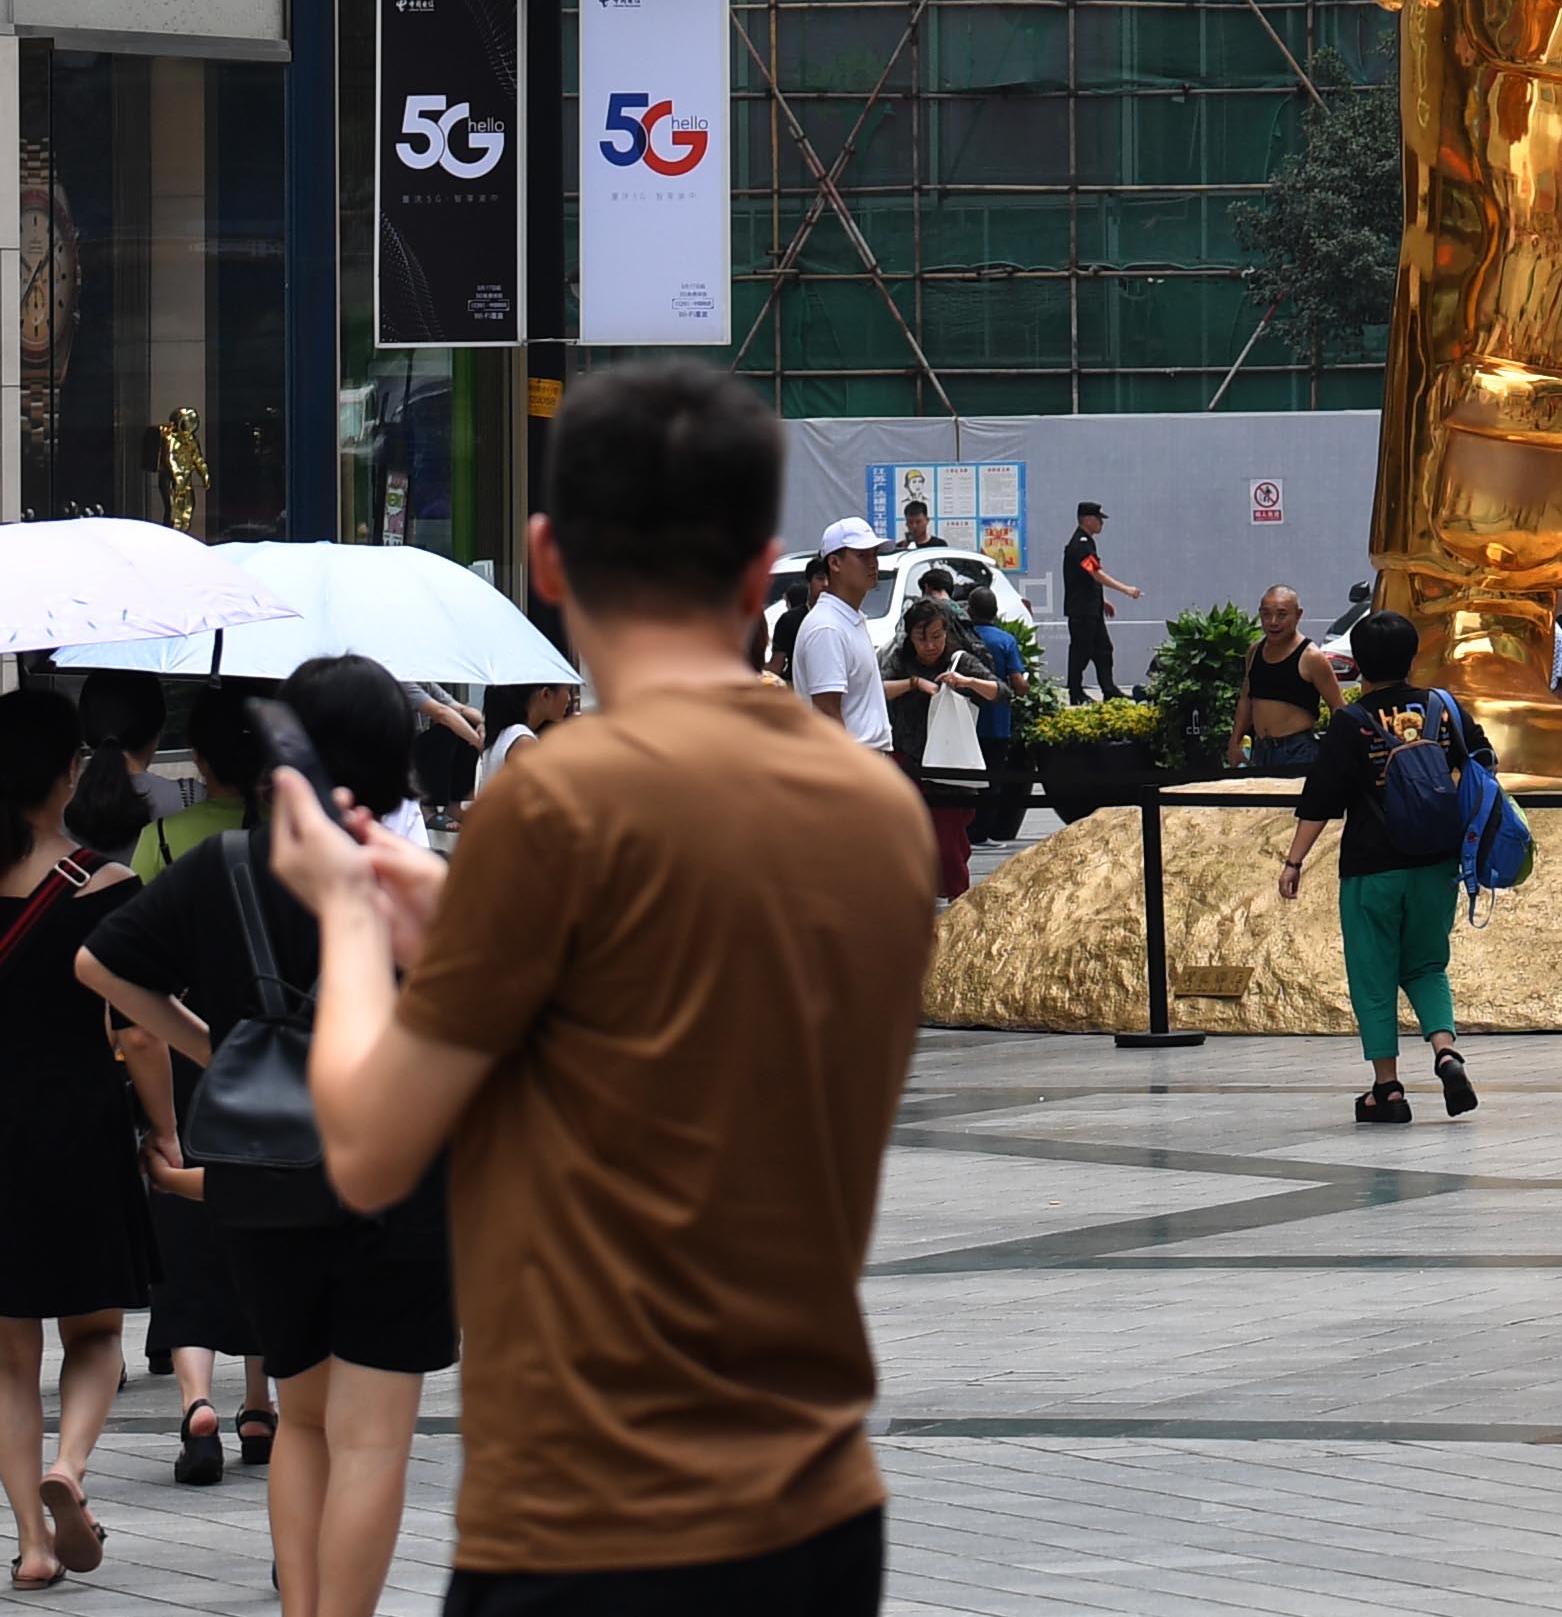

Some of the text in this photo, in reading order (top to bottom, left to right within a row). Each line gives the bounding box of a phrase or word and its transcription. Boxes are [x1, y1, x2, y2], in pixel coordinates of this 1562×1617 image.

[395, 94, 506, 179] 5G
[468, 116, 505, 133] hello
[599, 92, 709, 177] 5G
[671, 115, 709, 131] hello
